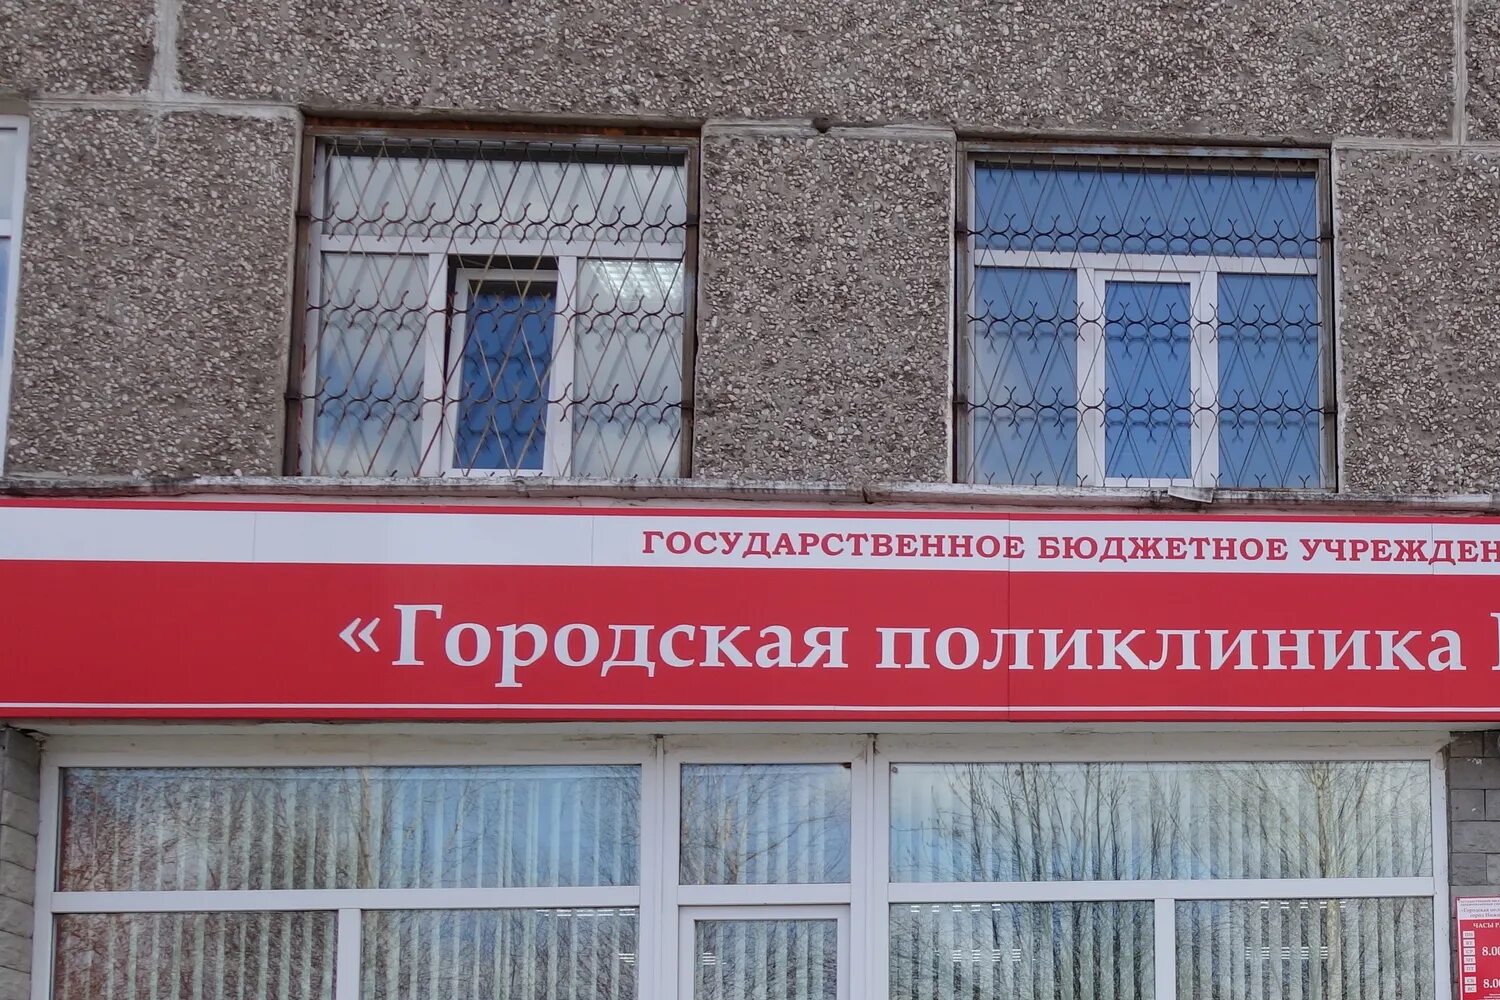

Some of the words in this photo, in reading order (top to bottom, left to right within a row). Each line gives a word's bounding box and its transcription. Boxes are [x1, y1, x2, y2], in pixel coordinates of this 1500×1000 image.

[643, 530, 1026, 561] ГОСУДАРСТВЕННОЕ
[1038, 534, 1288, 563] БЮДЖЕТНОЕ
[338, 603, 850, 689] «Городская
[876, 625, 1467, 673] поликлиника
